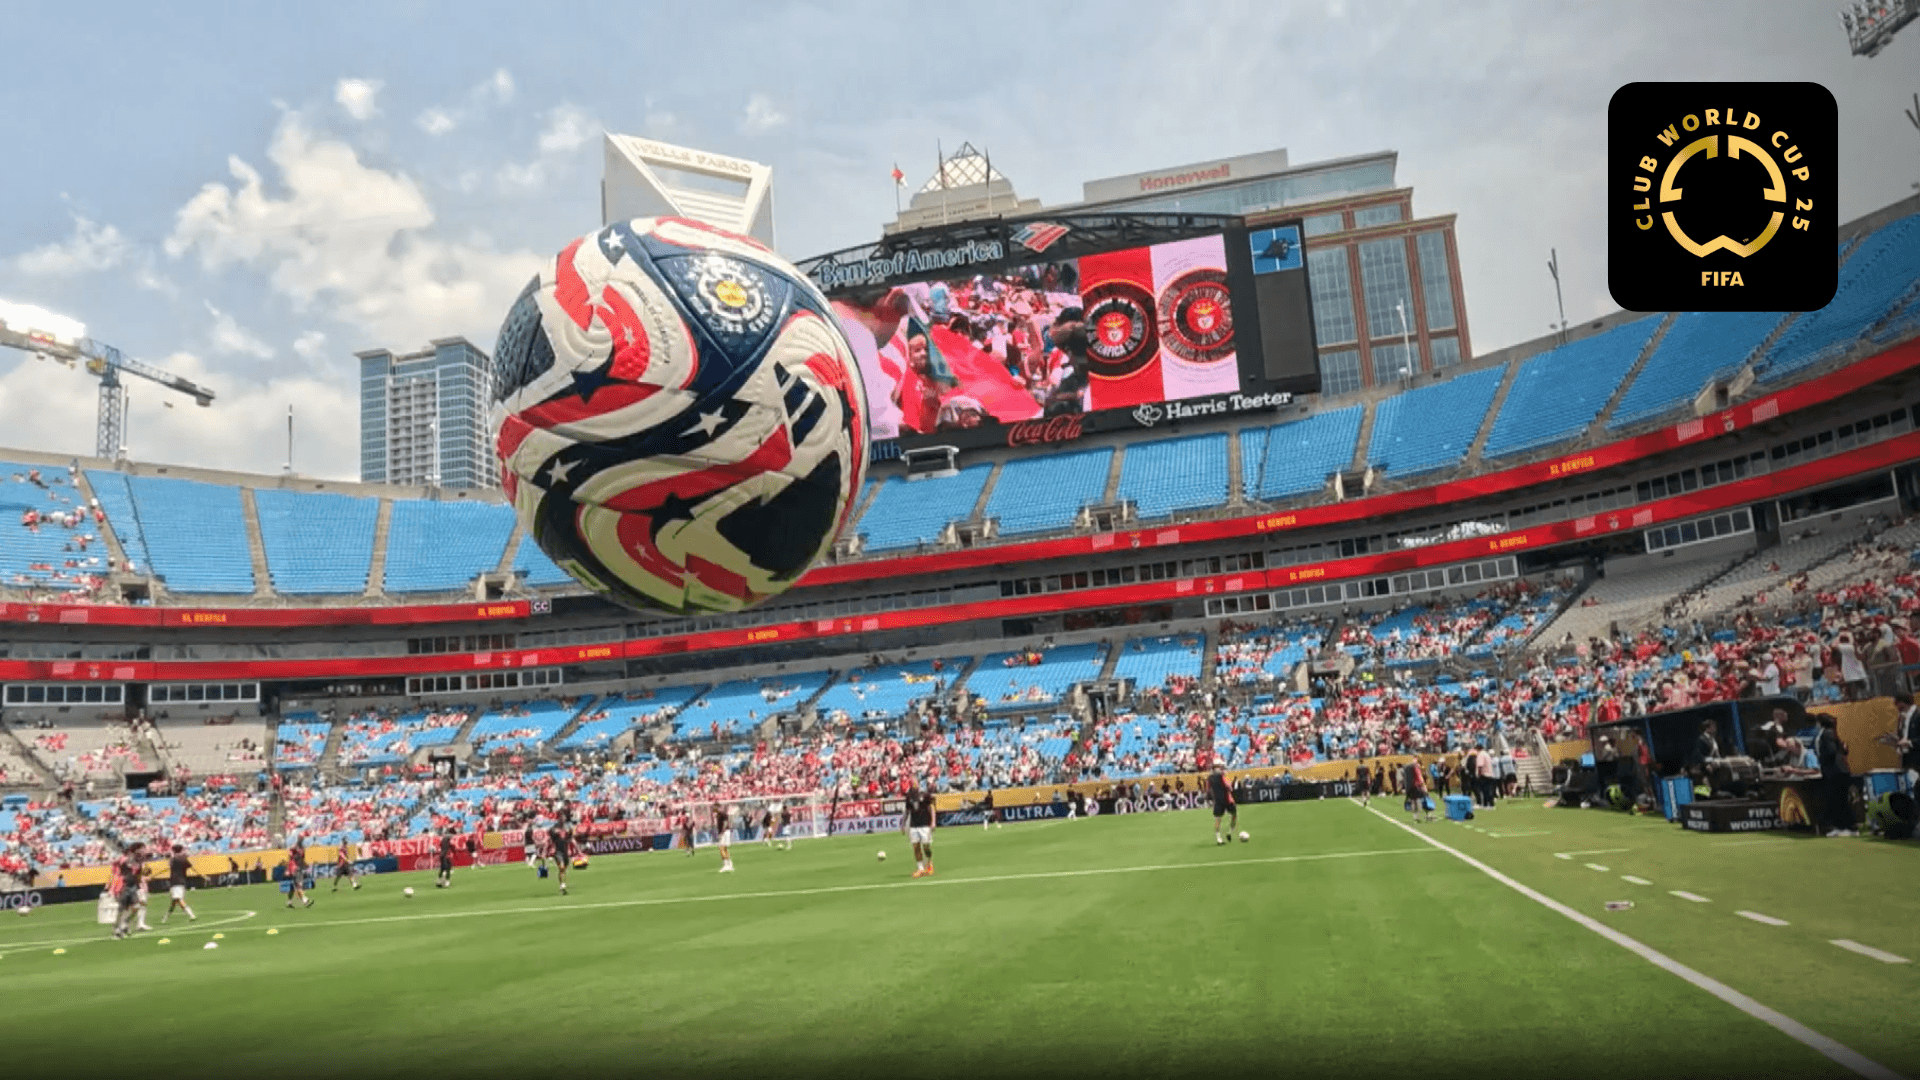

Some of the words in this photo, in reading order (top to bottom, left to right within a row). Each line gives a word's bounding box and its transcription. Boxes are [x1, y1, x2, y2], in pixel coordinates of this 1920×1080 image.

[631, 141, 692, 162] WELLS
[696, 153, 752, 174] FARGO
[1139, 163, 1230, 191] Honeywell
[818, 258, 877, 286] Bank
[876, 252, 905, 277] of
[905, 240, 1004, 273] America
[1166, 398, 1227, 419] Harris
[1229, 391, 1292, 411] Teeter
[1007, 413, 1086, 447] Coca-Cola
[1259, 787, 1282, 802] PIF
[1334, 782, 1357, 796] PIF
[1004, 805, 1055, 820] ULTRA
[1747, 807, 1774, 818] FIFA
[1730, 819, 1772, 831] WORLD
[0, 890, 42, 910] rola
